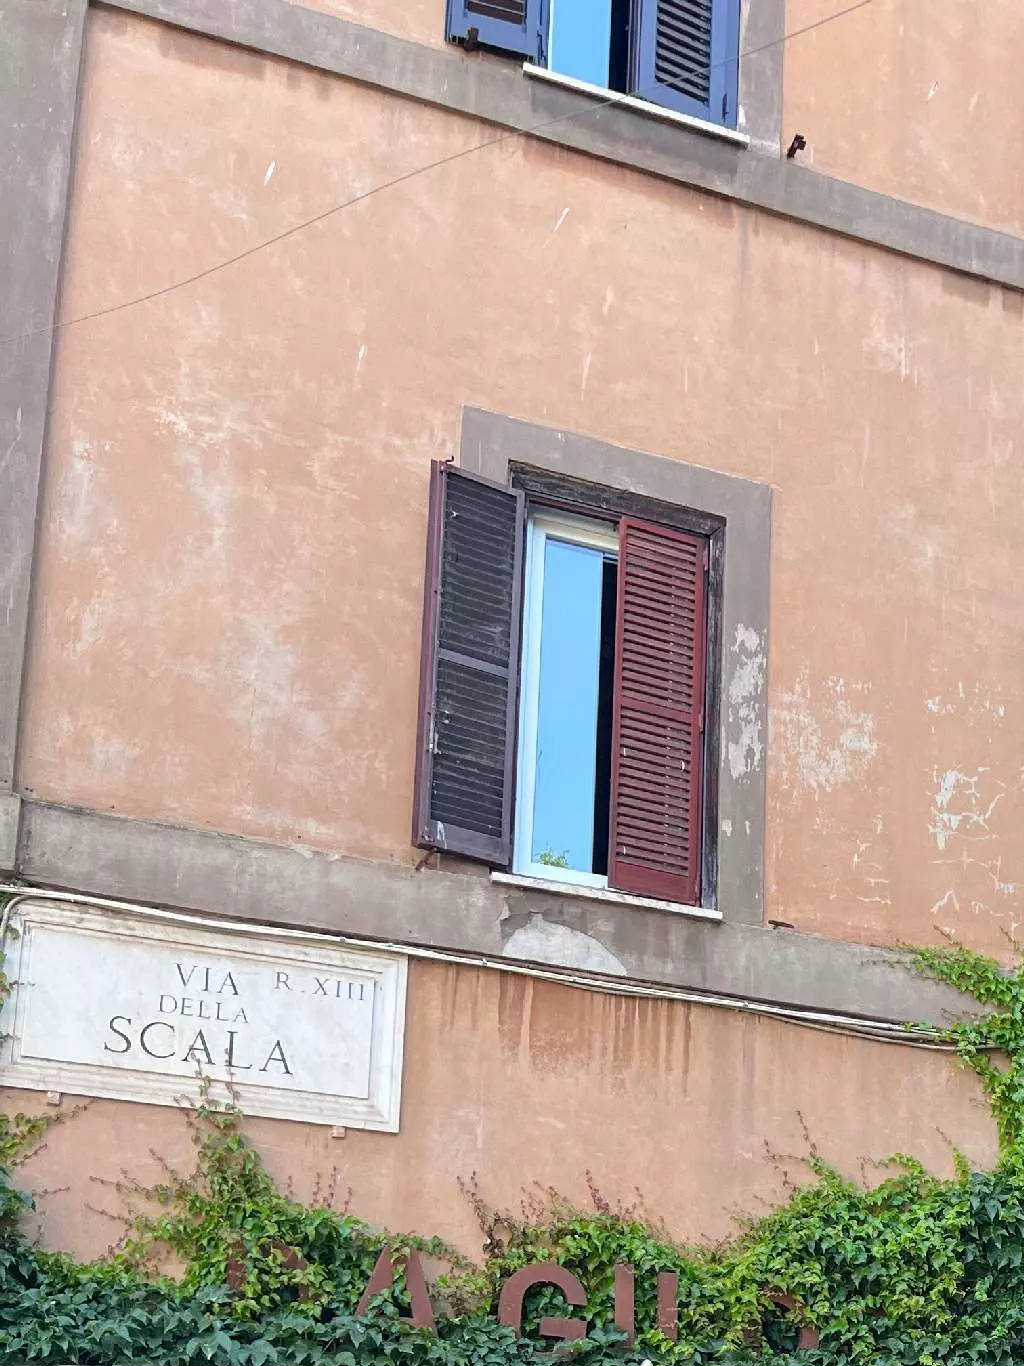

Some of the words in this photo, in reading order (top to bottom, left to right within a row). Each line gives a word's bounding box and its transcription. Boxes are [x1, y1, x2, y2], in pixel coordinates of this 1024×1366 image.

[175, 962, 240, 996] VIA
[159, 994, 249, 1024] DELLA
[103, 1015, 294, 1076] SCALA
